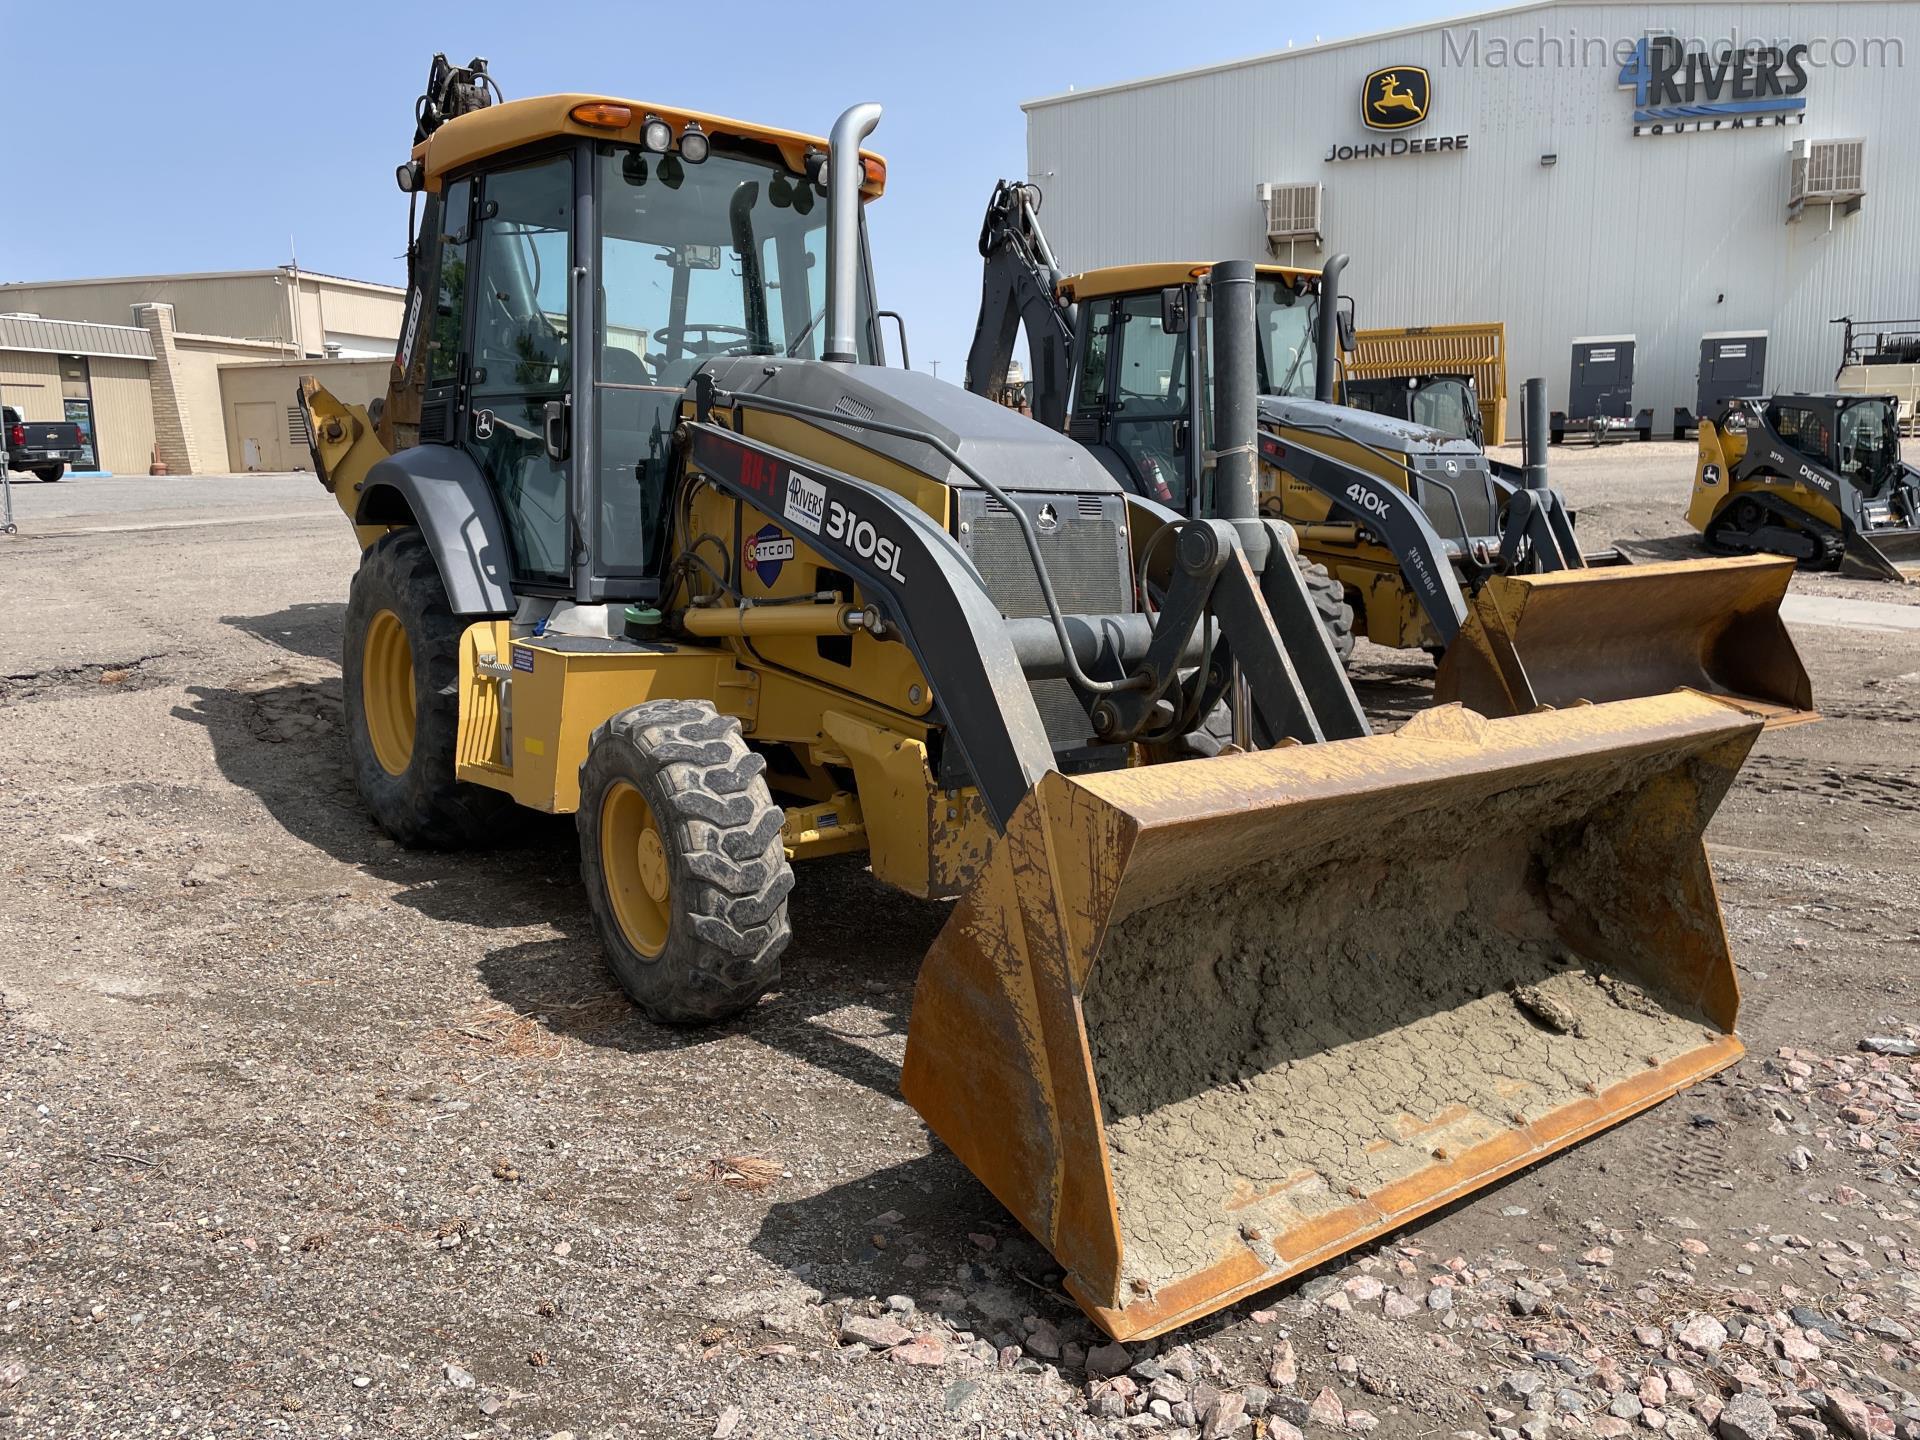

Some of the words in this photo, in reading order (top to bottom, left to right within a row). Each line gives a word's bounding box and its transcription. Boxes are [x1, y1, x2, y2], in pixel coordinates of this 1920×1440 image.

[1633, 112, 1806, 137] EQUIPMENT
[1324, 143, 1385, 162] JOHN
[1391, 134, 1469, 155] DEERE
[1799, 464, 1832, 491] DEERE
[1346, 483, 1391, 520] 410K
[825, 500, 906, 584] 310SL
